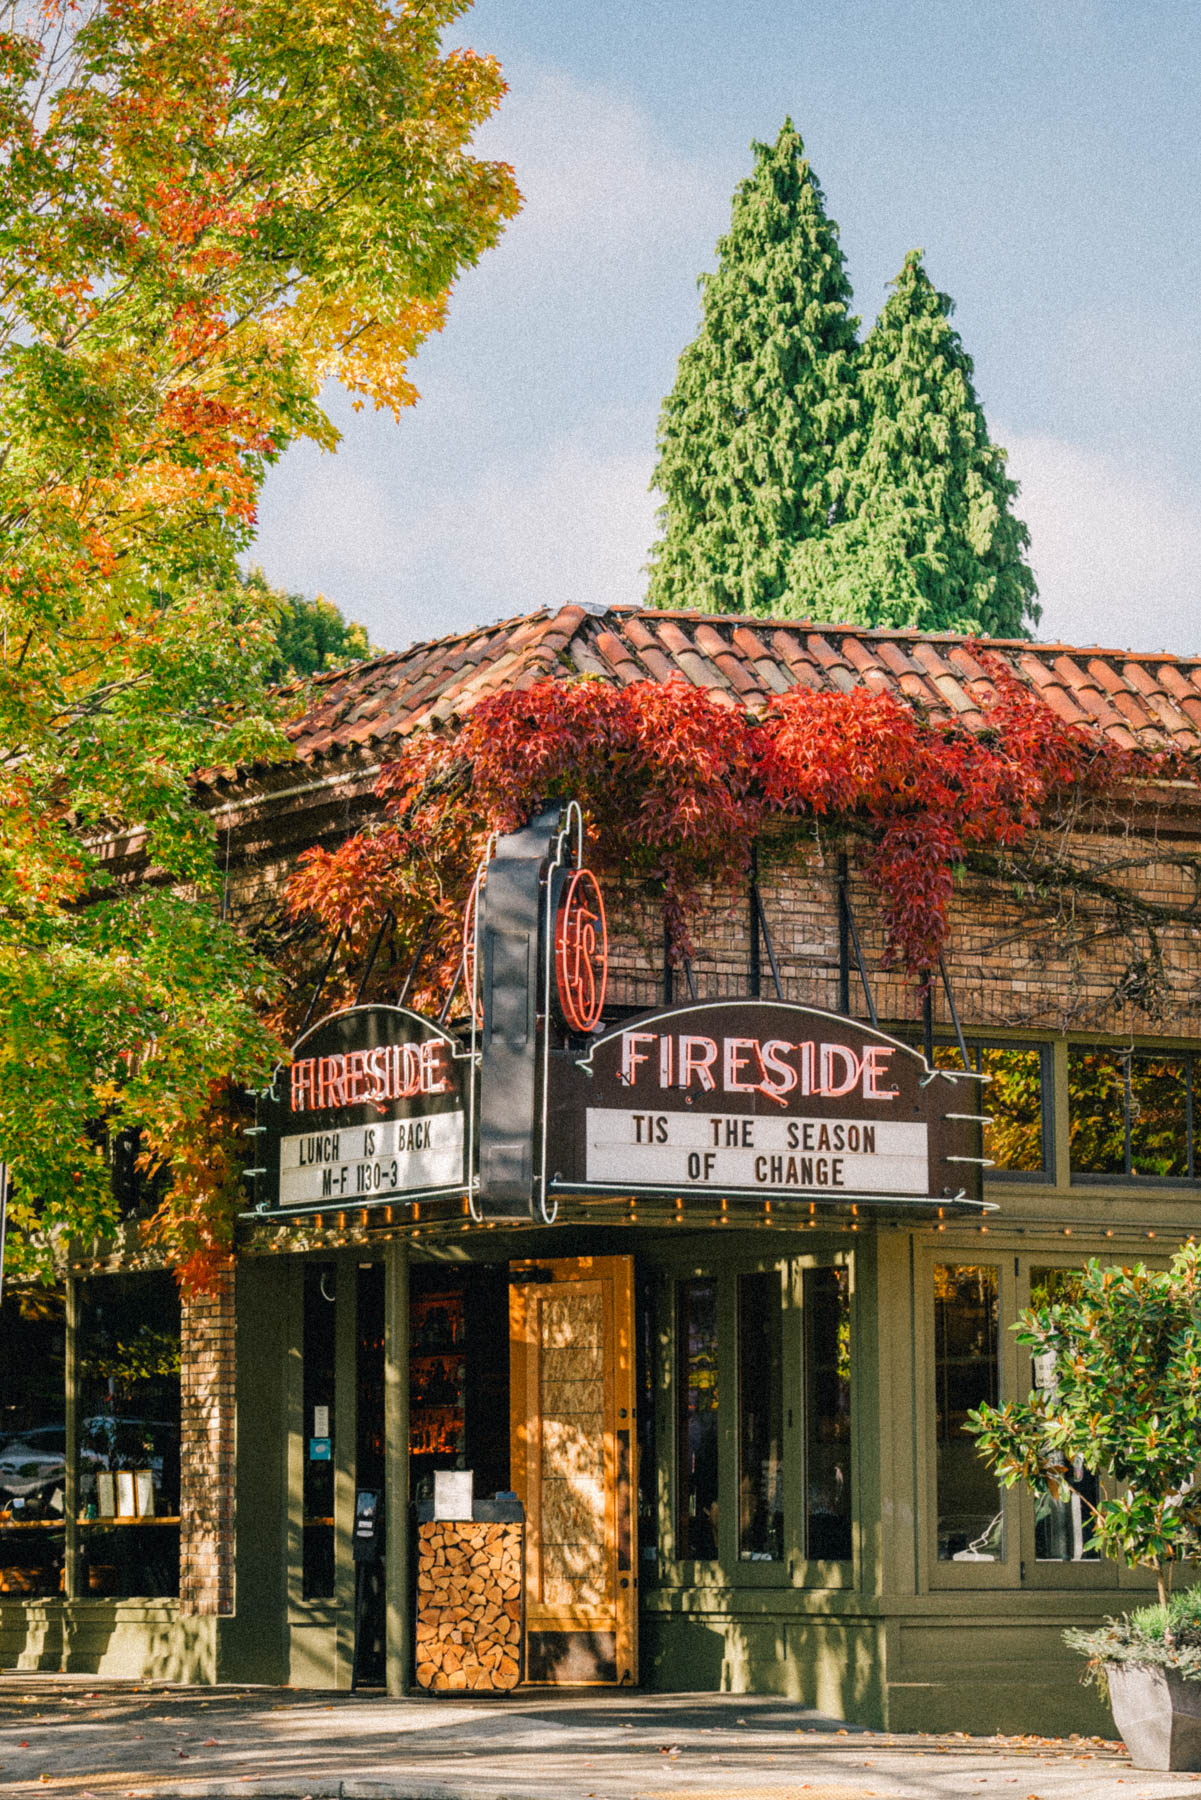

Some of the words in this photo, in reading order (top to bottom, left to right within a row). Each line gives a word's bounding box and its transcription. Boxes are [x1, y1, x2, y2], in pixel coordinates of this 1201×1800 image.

[290, 1038, 445, 1112] FIRESIDE
[621, 1032, 900, 1101] FIRESIDE
[299, 1133, 340, 1165] LUNCH
[364, 1129, 376, 1157] IS
[399, 1121, 432, 1151] BACK
[632, 1114, 669, 1144] TIS
[710, 1118, 755, 1149] THE
[787, 1122, 877, 1154] SEASON
[322, 1166, 348, 1196] M-F
[356, 1160, 398, 1190] 1130-3
[687, 1152, 717, 1181] OF
[754, 1156, 845, 1187] CHANGE
